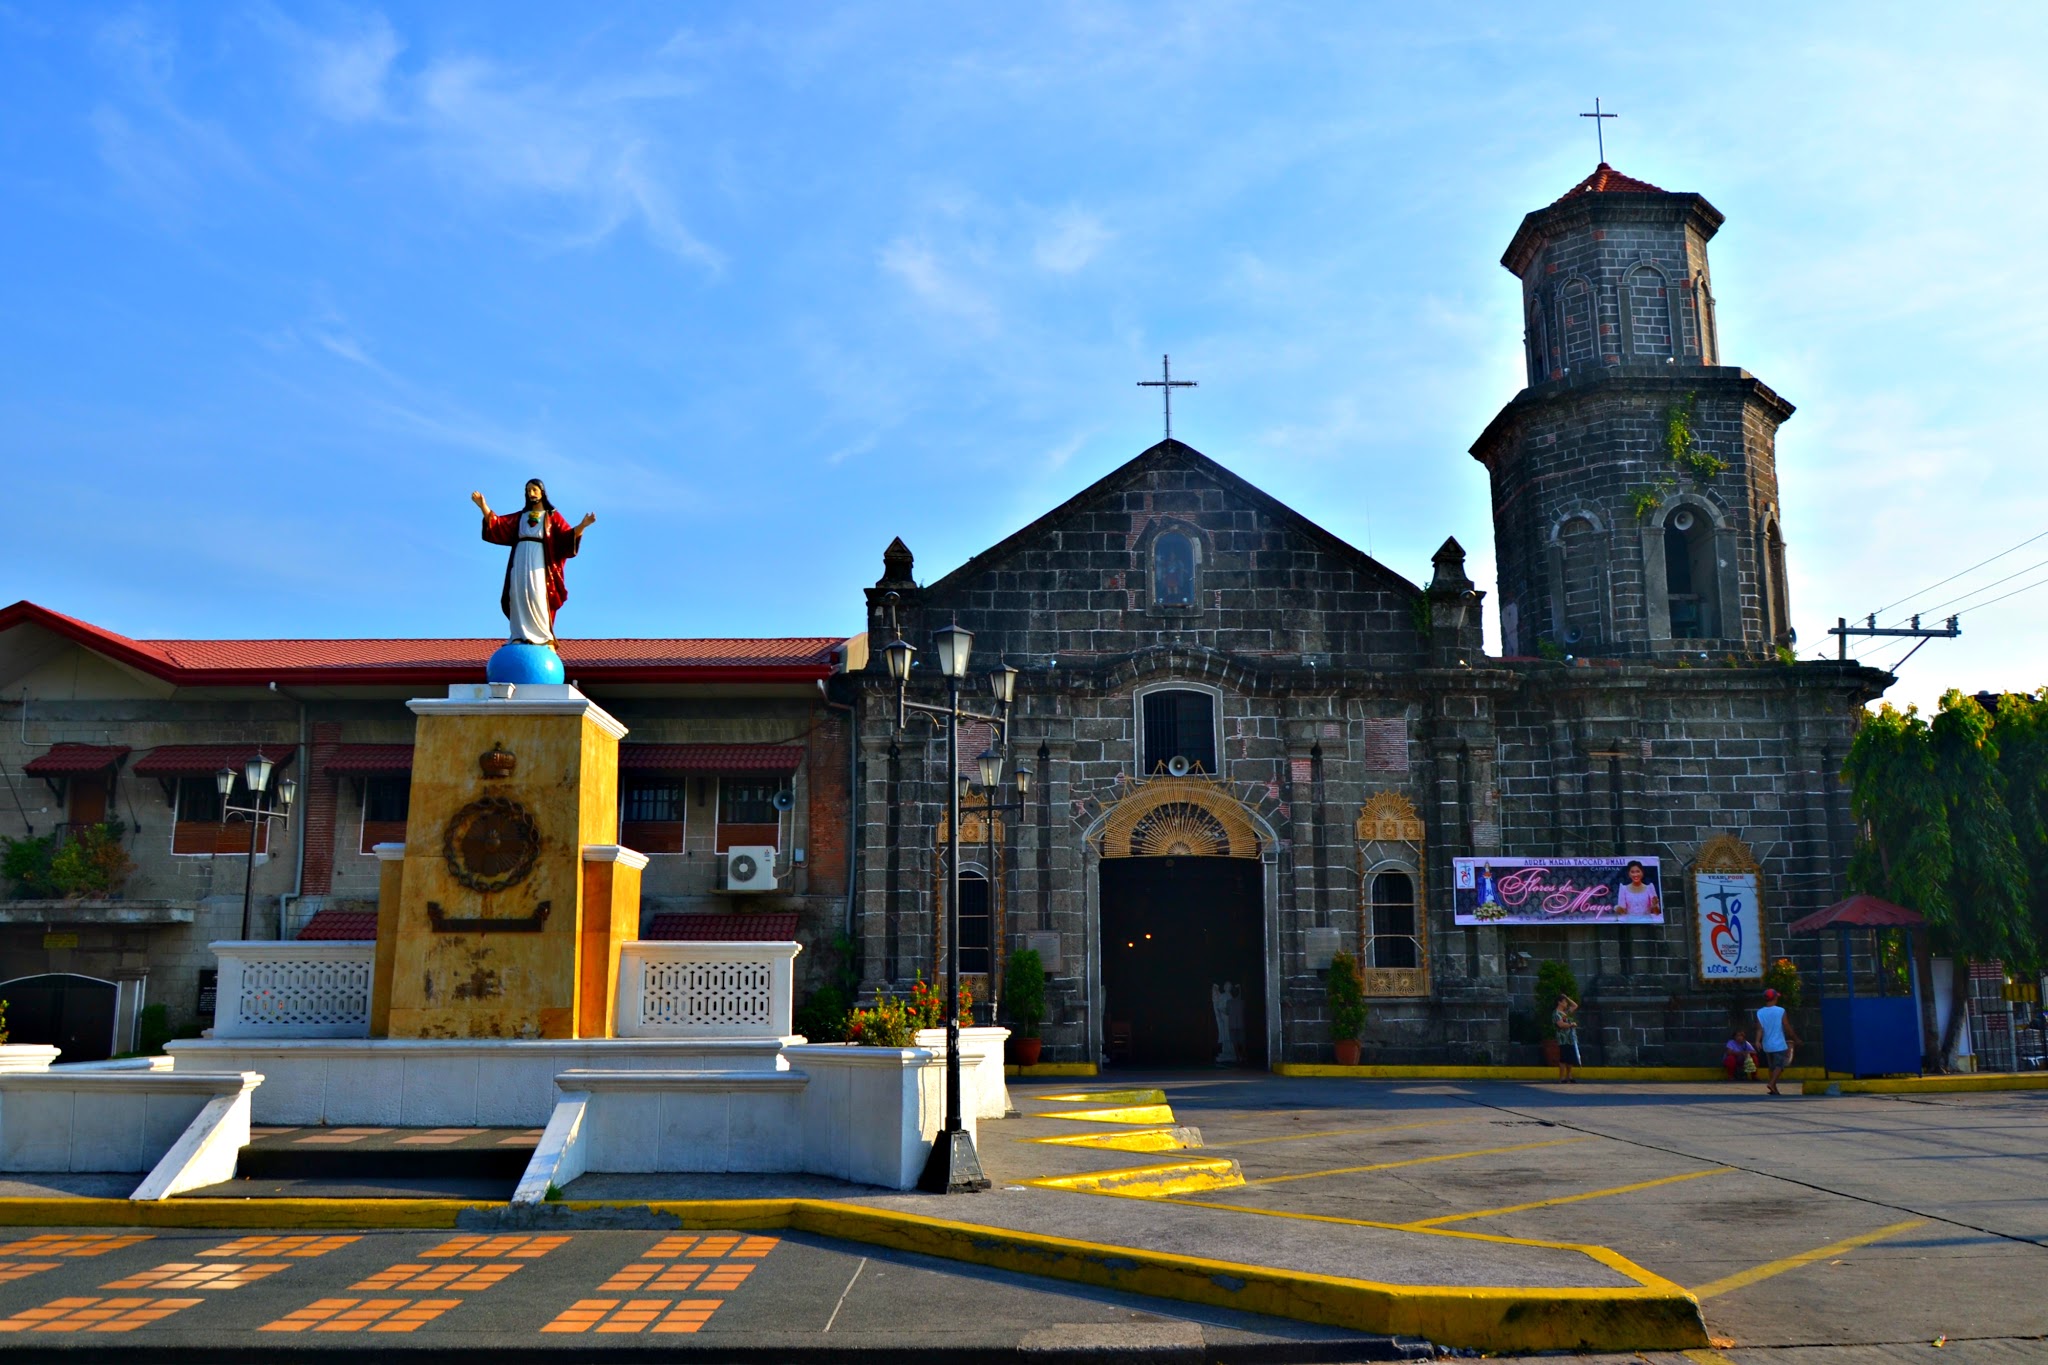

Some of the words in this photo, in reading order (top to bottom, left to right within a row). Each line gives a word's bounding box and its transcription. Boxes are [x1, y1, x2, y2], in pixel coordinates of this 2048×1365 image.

[1498, 868, 1555, 905] Flores
[1559, 880, 1574, 892] de
[1543, 885, 1613, 919] Mayo
[1707, 964, 1728, 974] LOOK
[1735, 965, 1758, 977] JESUS
